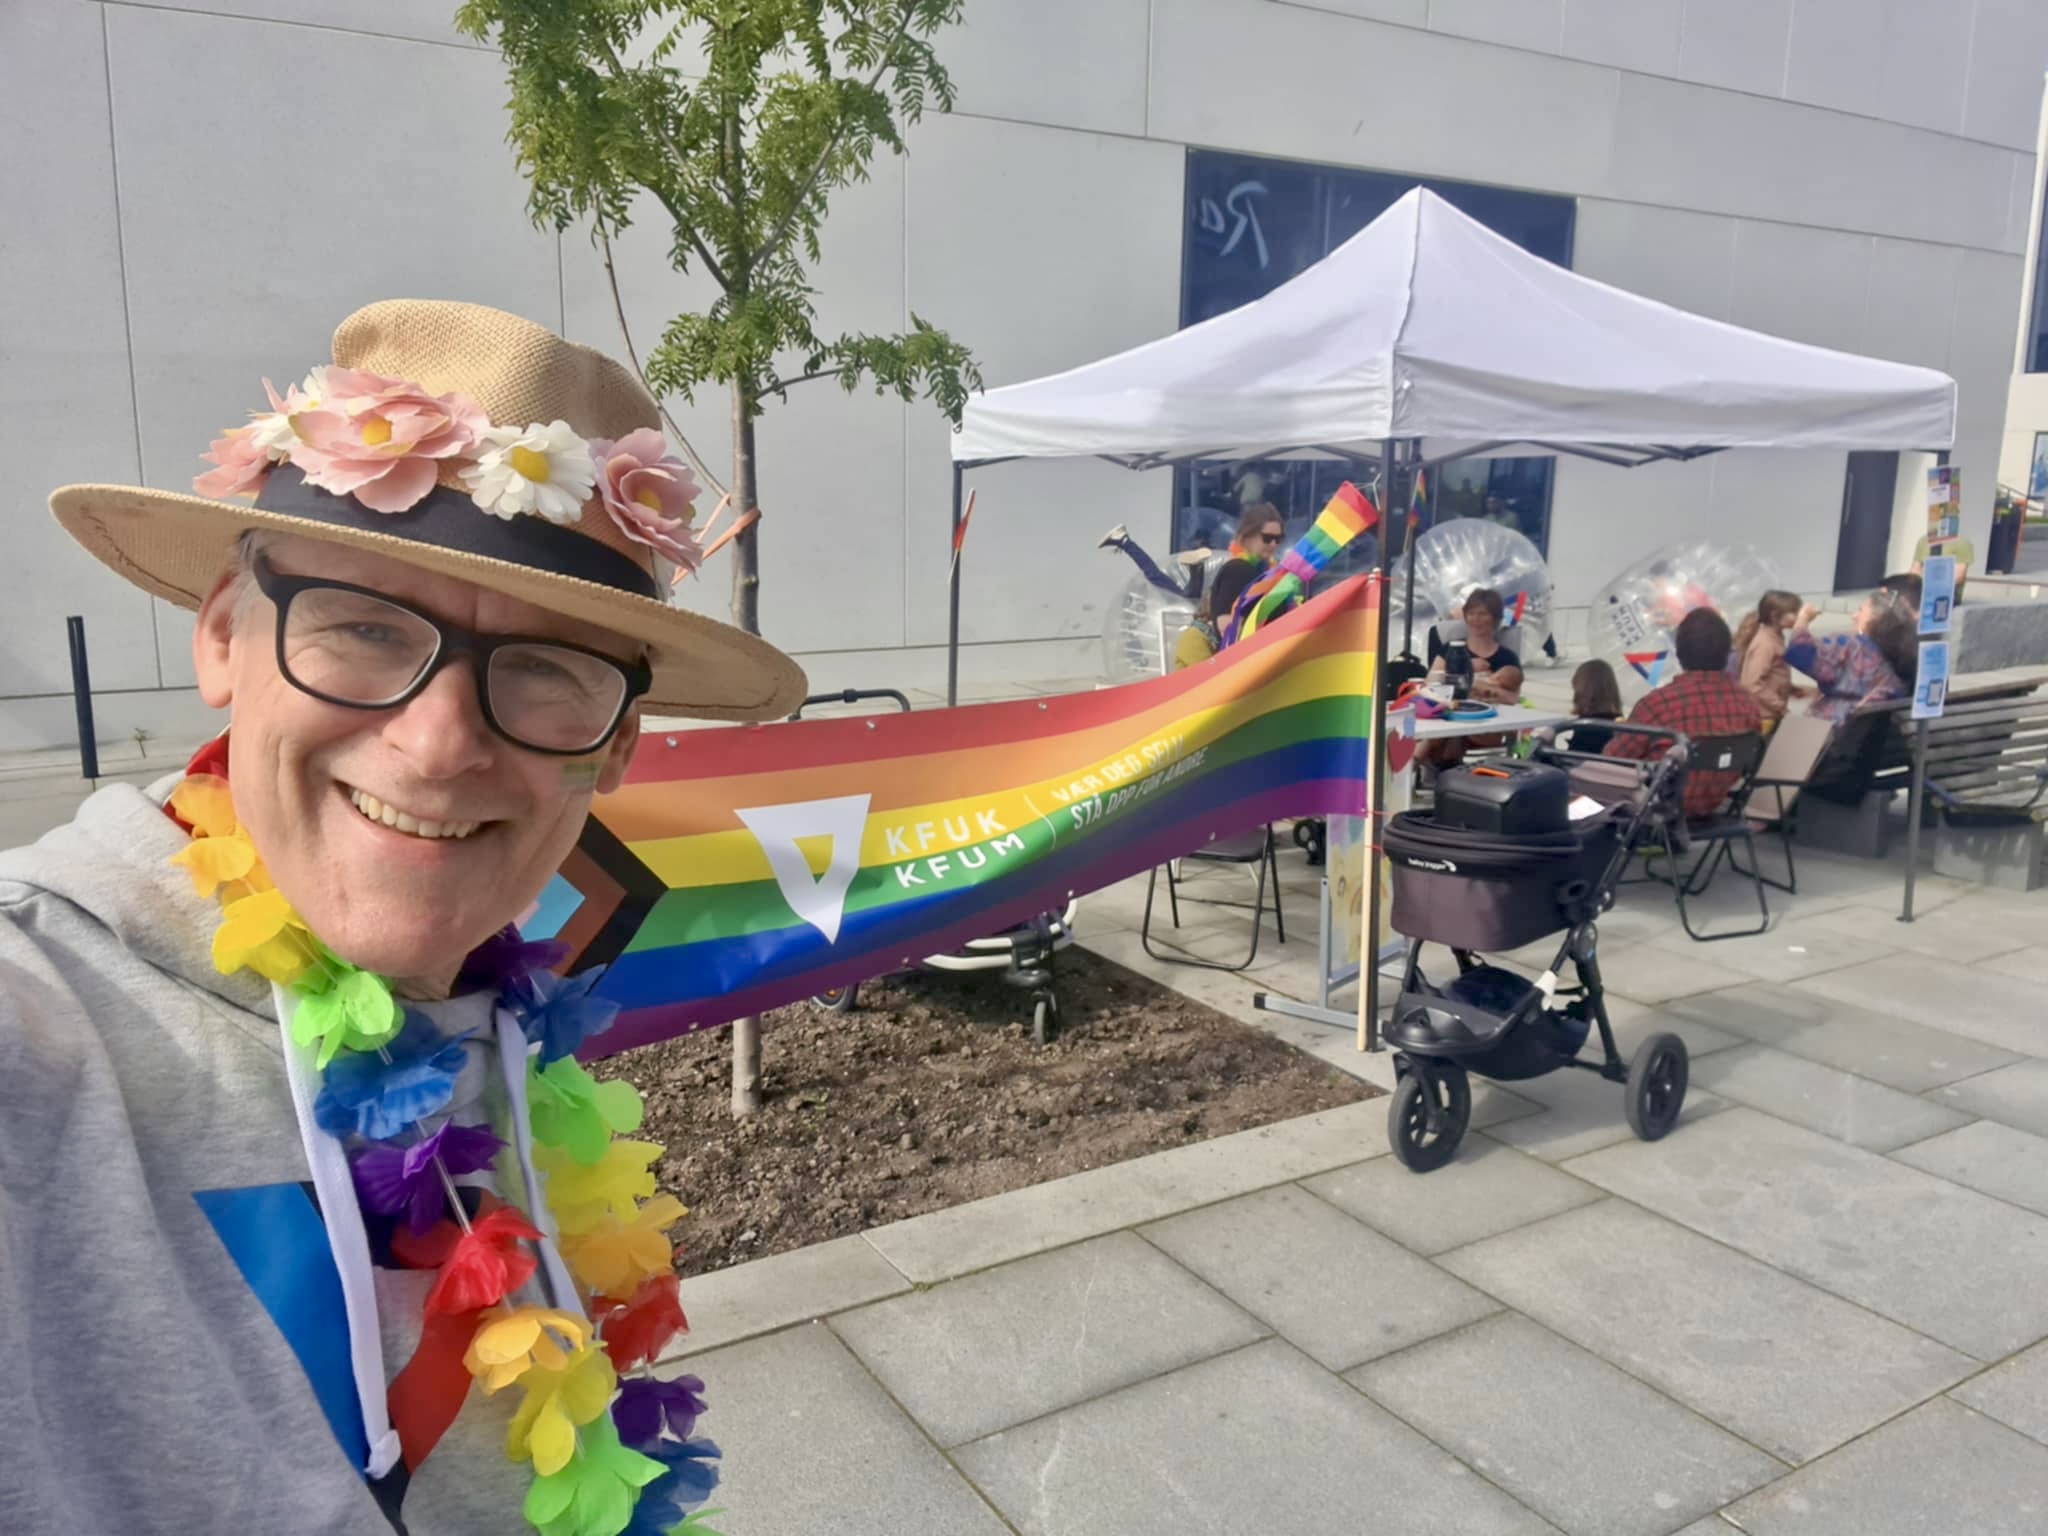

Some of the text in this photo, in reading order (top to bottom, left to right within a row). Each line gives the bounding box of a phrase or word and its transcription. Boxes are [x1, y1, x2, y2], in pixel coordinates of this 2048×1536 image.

[1101, 753, 1143, 782] DEG
[884, 807, 1007, 856] KFUK
[1070, 792, 1103, 830] STÅ
[894, 832, 1026, 888] KFUM
